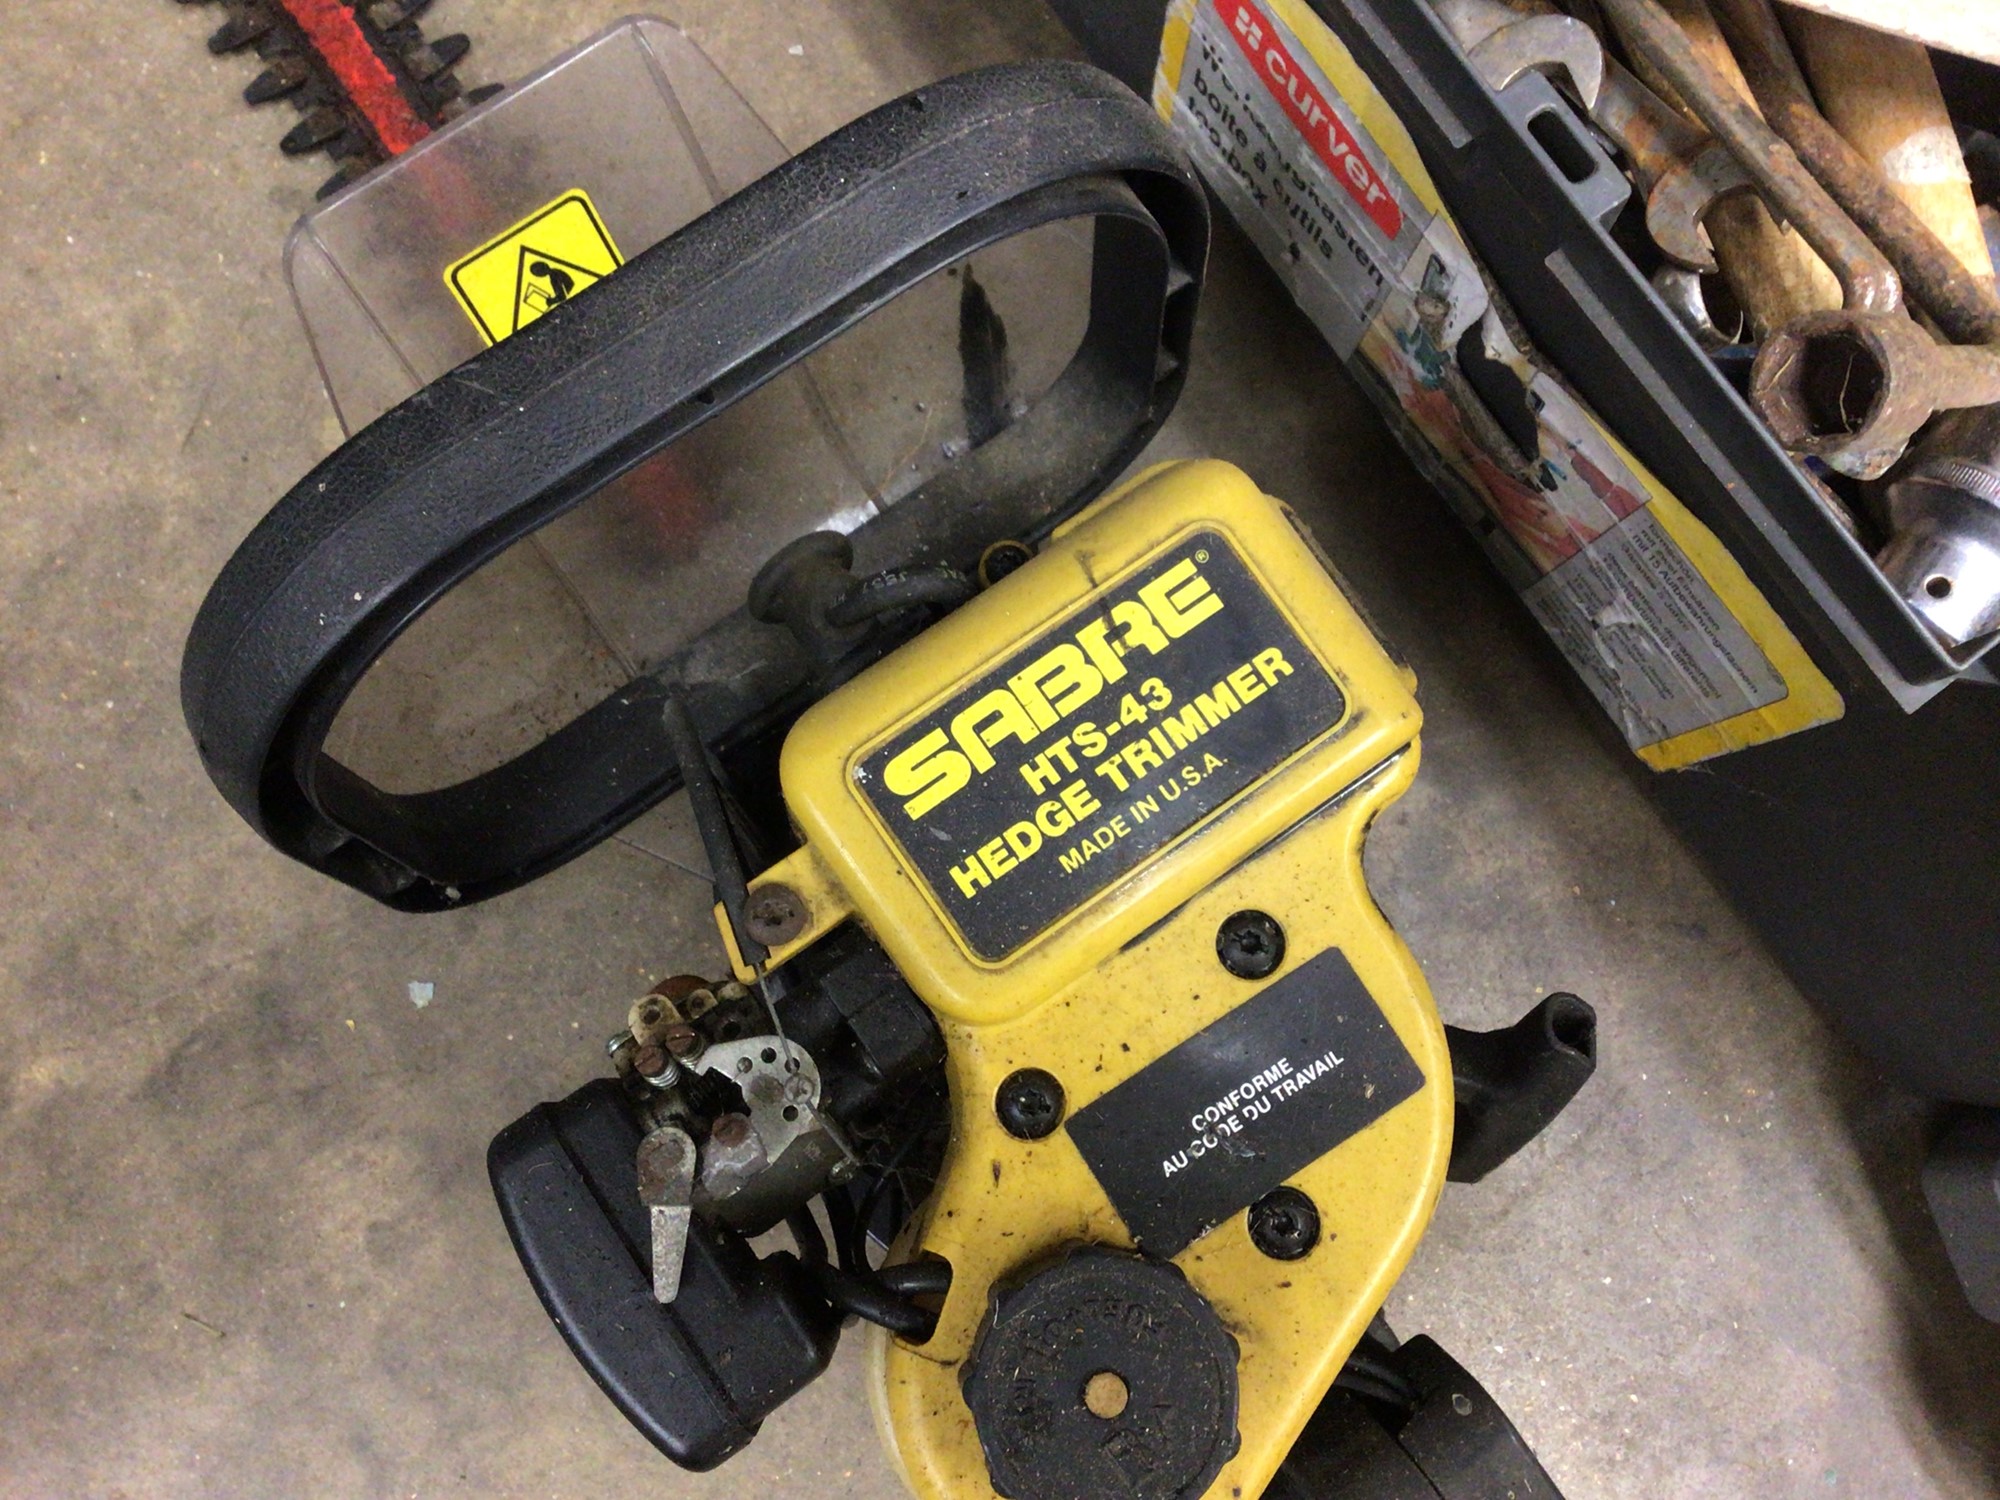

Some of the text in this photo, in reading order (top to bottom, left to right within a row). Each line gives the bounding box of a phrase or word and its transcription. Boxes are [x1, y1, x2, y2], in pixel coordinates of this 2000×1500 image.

[1266, 50, 1386, 204] curver
[1632, 535, 1649, 553] mit
[1649, 554, 1661, 570] 15
[882, 557, 1225, 821] SABRE
[1018, 677, 1174, 795] HTS-43
[949, 646, 1294, 899] HEDGE TRIMMER
[1058, 818, 1131, 875] MADE
[1129, 794, 1161, 825] IN
[1162, 1051, 1344, 1178] AU CODE DU TRAVAIL
[1191, 1057, 1294, 1132] CONFORME
